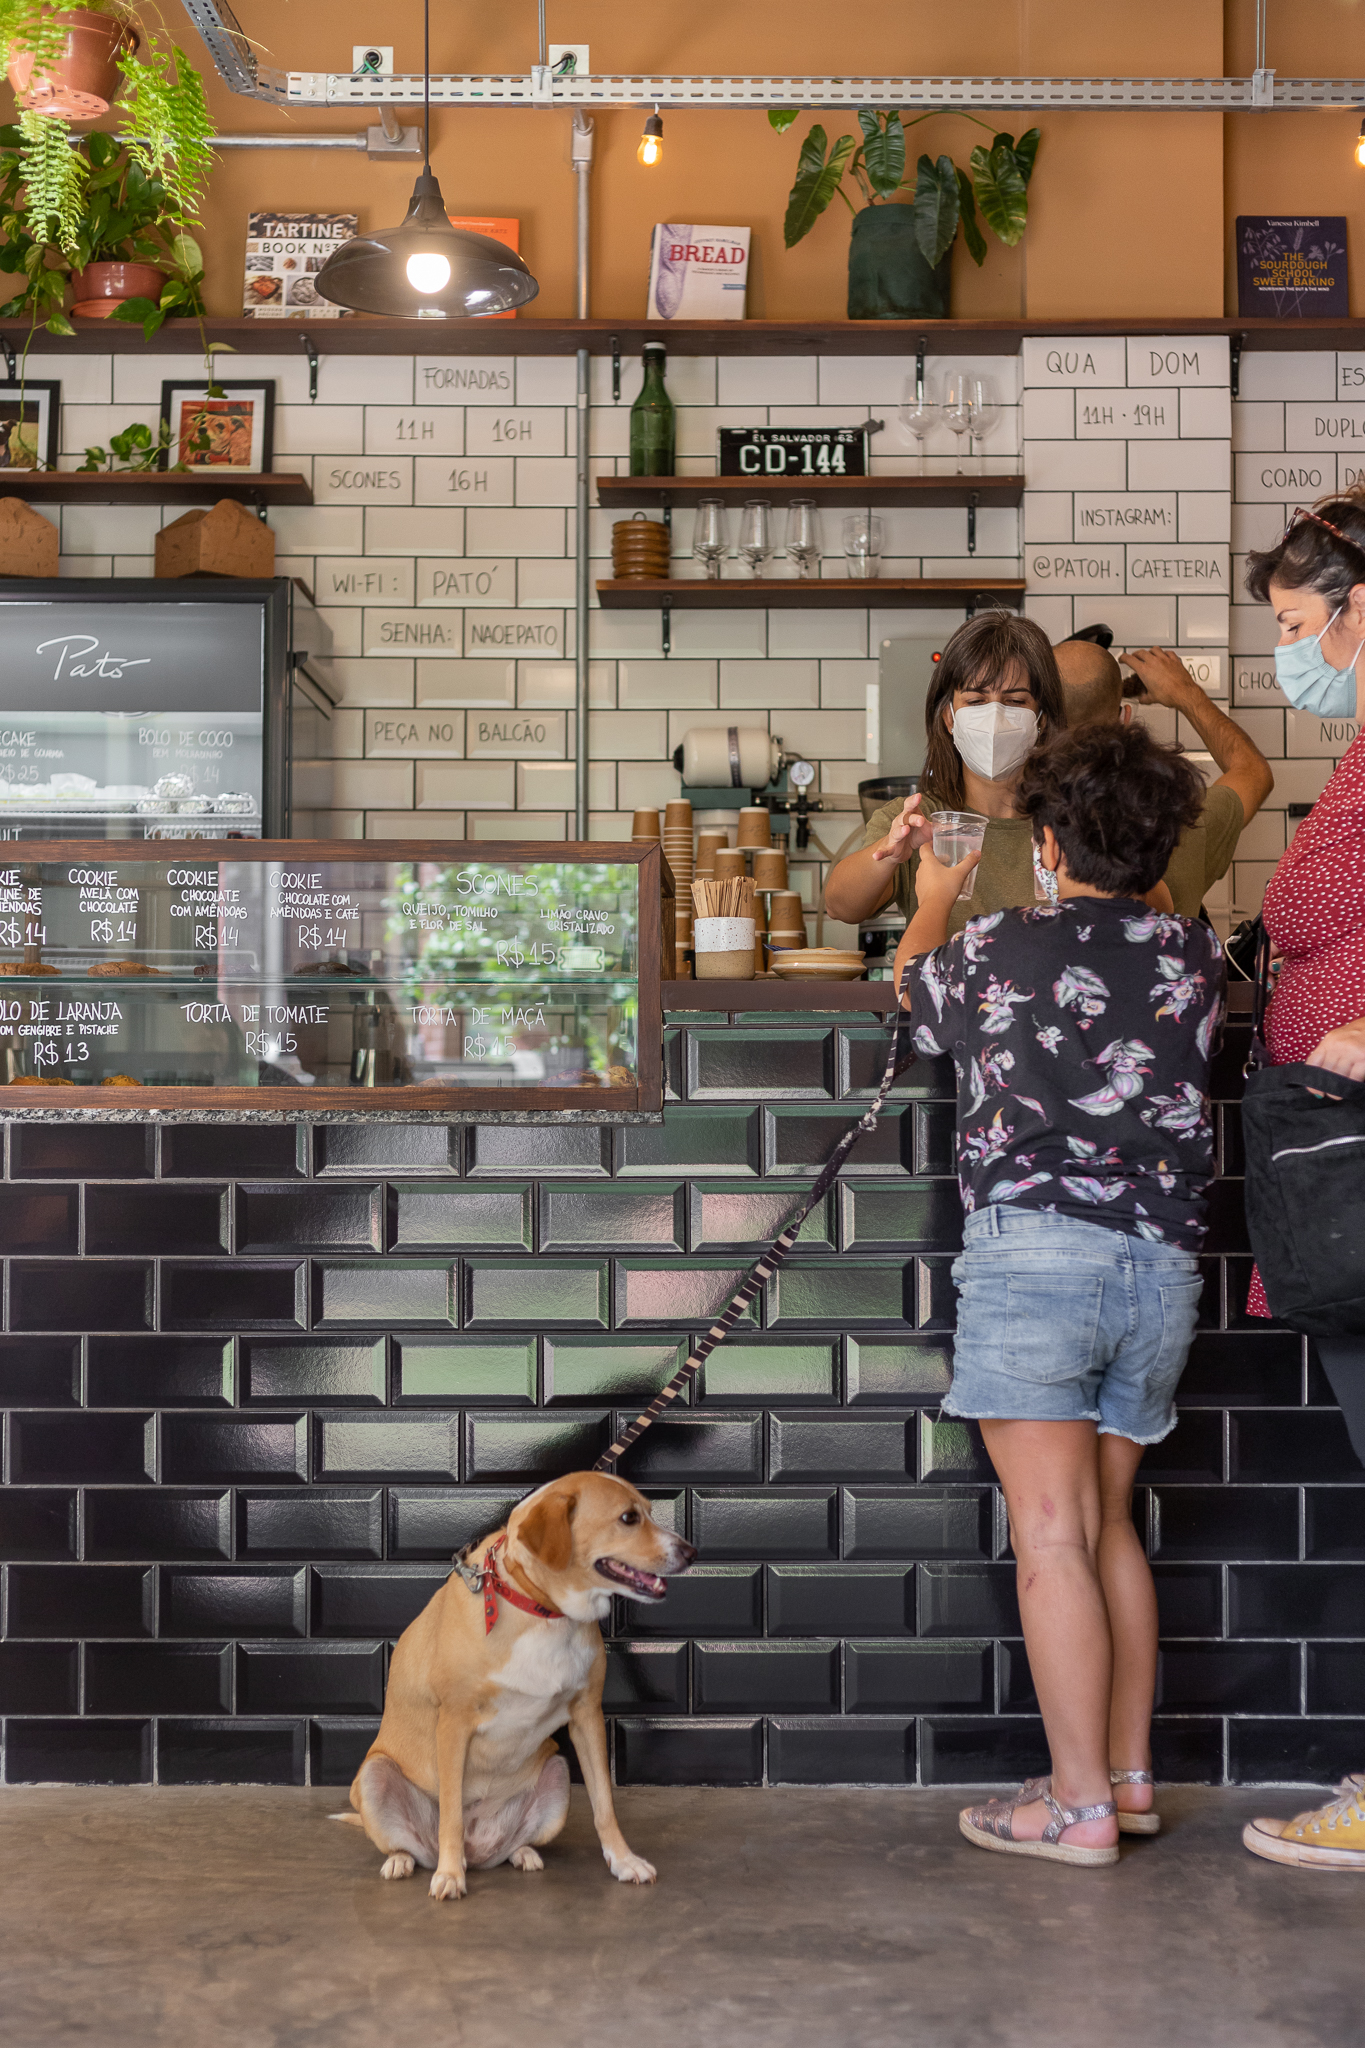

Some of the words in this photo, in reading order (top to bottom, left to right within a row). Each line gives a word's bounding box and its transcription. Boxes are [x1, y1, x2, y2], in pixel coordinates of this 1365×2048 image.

[263, 222, 344, 238] TARTINE
[262, 242, 307, 254] BOOK
[669, 244, 746, 265] BREAD
[1283, 252, 1304, 261] THE
[1260, 261, 1328, 270] SOURDOUGH
[1271, 269, 1316, 278] SCHOOL
[1253, 277, 1290, 287] SWEET
[1293, 277, 1335, 287] BAKING
[1046, 350, 1097, 375] QUA
[1149, 351, 1200, 376] DOM
[422, 366, 511, 390] FORNADAS
[1082, 405, 1114, 425] 11H
[1133, 404, 1165, 426] 19H
[1314, 417, 1365, 438] DUPL
[752, 434, 768, 443] EL
[770, 434, 831, 443] SALVADOR
[739, 444, 847, 474] CD-144
[328, 469, 402, 490] SCONES
[448, 468, 488, 492] 16H
[1260, 468, 1322, 488] COADO
[1080, 508, 1172, 528] INSTAGRAM:
[1131, 558, 1222, 579] CAFETERIA
[380, 621, 453, 645] SENHA:
[471, 624, 558, 646] NAOEPATO
[138, 727, 171, 746] BOLO
[178, 730, 195, 747] DE
[198, 730, 234, 748] COCO
[373, 720, 420, 745] PEÇA
[428, 723, 454, 742] NO
[478, 719, 546, 743] BALCÃO
[68, 868, 118, 887] COOKIE
[166, 869, 219, 887] COOKIE
[269, 870, 323, 890] COOKIE
[456, 871, 539, 897] SCONES
[27, 887, 42, 901] DE
[79, 886, 112, 901] AVELÃ
[116, 888, 140, 901] COM
[181, 889, 240, 903] CHOCOLATE
[278, 891, 330, 906] CHOCOLATE
[331, 894, 351, 906] COM
[79, 901, 139, 914] CHOCOLATE
[170, 905, 192, 917] COM
[194, 903, 248, 919] AMÊNDOAS
[269, 904, 322, 920] AMÊNDOAS
[324, 908, 333, 920] E
[335, 903, 360, 920] CAFÉ
[402, 902, 451, 920] QUEIJO,
[452, 904, 498, 919] TOMILHO
[539, 903, 572, 920] LIMÃO
[575, 909, 609, 922] CRAVO
[409, 919, 417, 930] E
[419, 918, 444, 931] FLOR
[449, 920, 462, 932] DE
[465, 920, 488, 932] SAL
[547, 920, 615, 936] CRISTALIZADO
[29, 1000, 51, 1021] DE
[55, 1000, 123, 1022] LARANJA
[180, 1001, 232, 1024] TORTA
[241, 1004, 261, 1023] DE
[264, 1004, 330, 1025] TOMATE
[406, 1005, 457, 1027] TORTA
[471, 1006, 493, 1026] DE
[501, 1002, 546, 1032] MAÇÃ
[17, 1024, 62, 1037] GENGIBRE
[65, 1024, 75, 1036] E
[78, 1023, 120, 1036] PISTACHE
